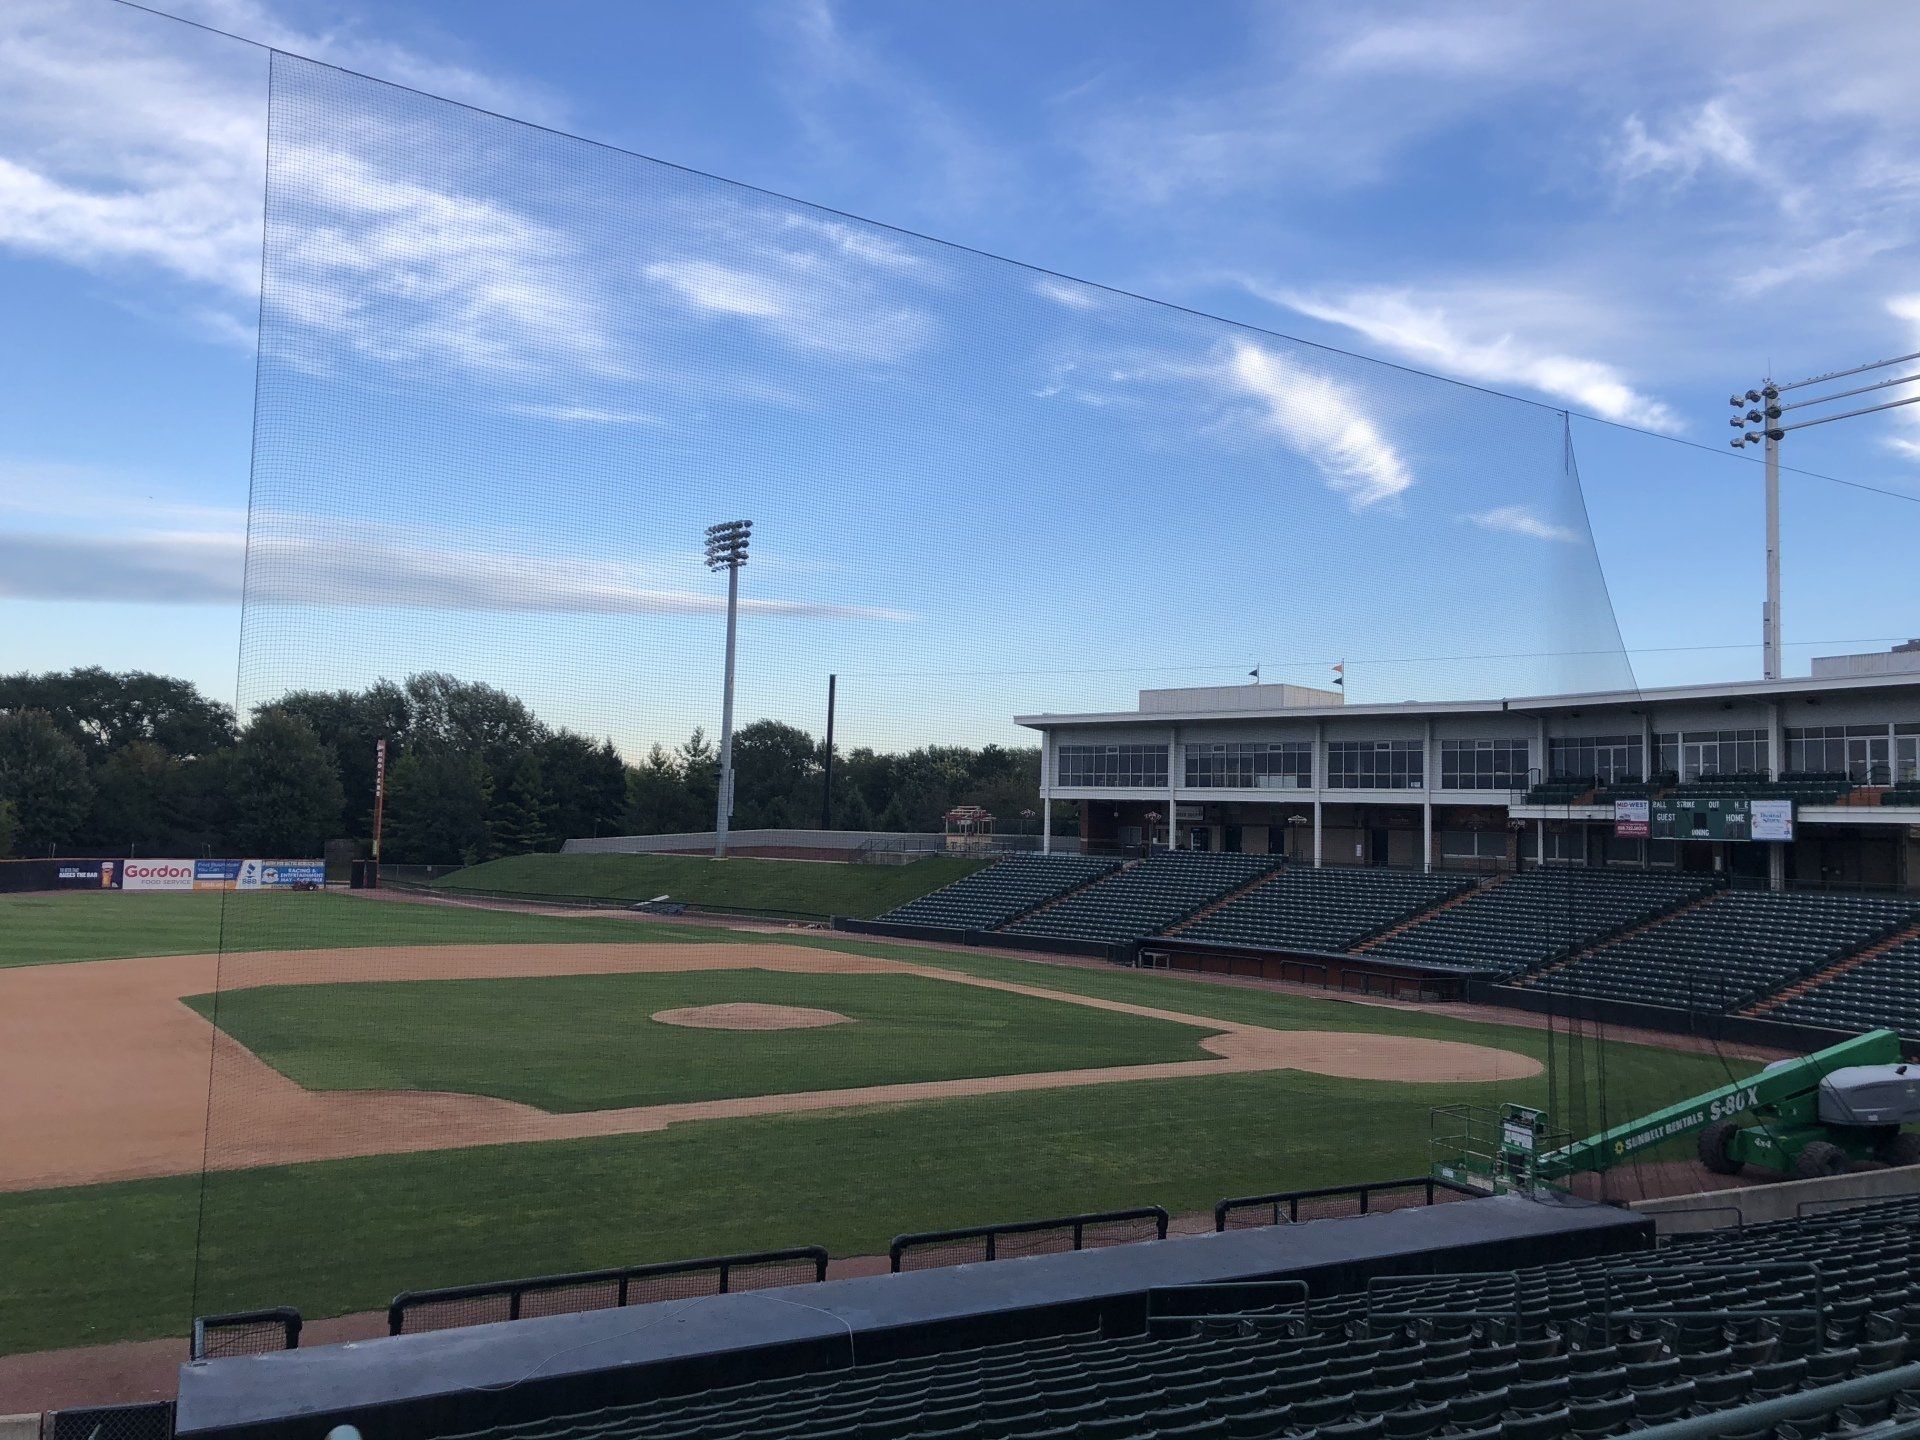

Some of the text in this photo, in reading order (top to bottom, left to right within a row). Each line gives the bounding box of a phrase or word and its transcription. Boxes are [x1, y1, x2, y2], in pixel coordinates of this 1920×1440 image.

[1656, 813, 1676, 821] GUEST
[1725, 814, 1745, 822] HOME
[124, 864, 192, 878] Gordon
[1625, 1126, 1665, 1150] SUNBELT
[1665, 1112, 1704, 1135] RENTALS
[1754, 1137, 1772, 1148] 4x4
